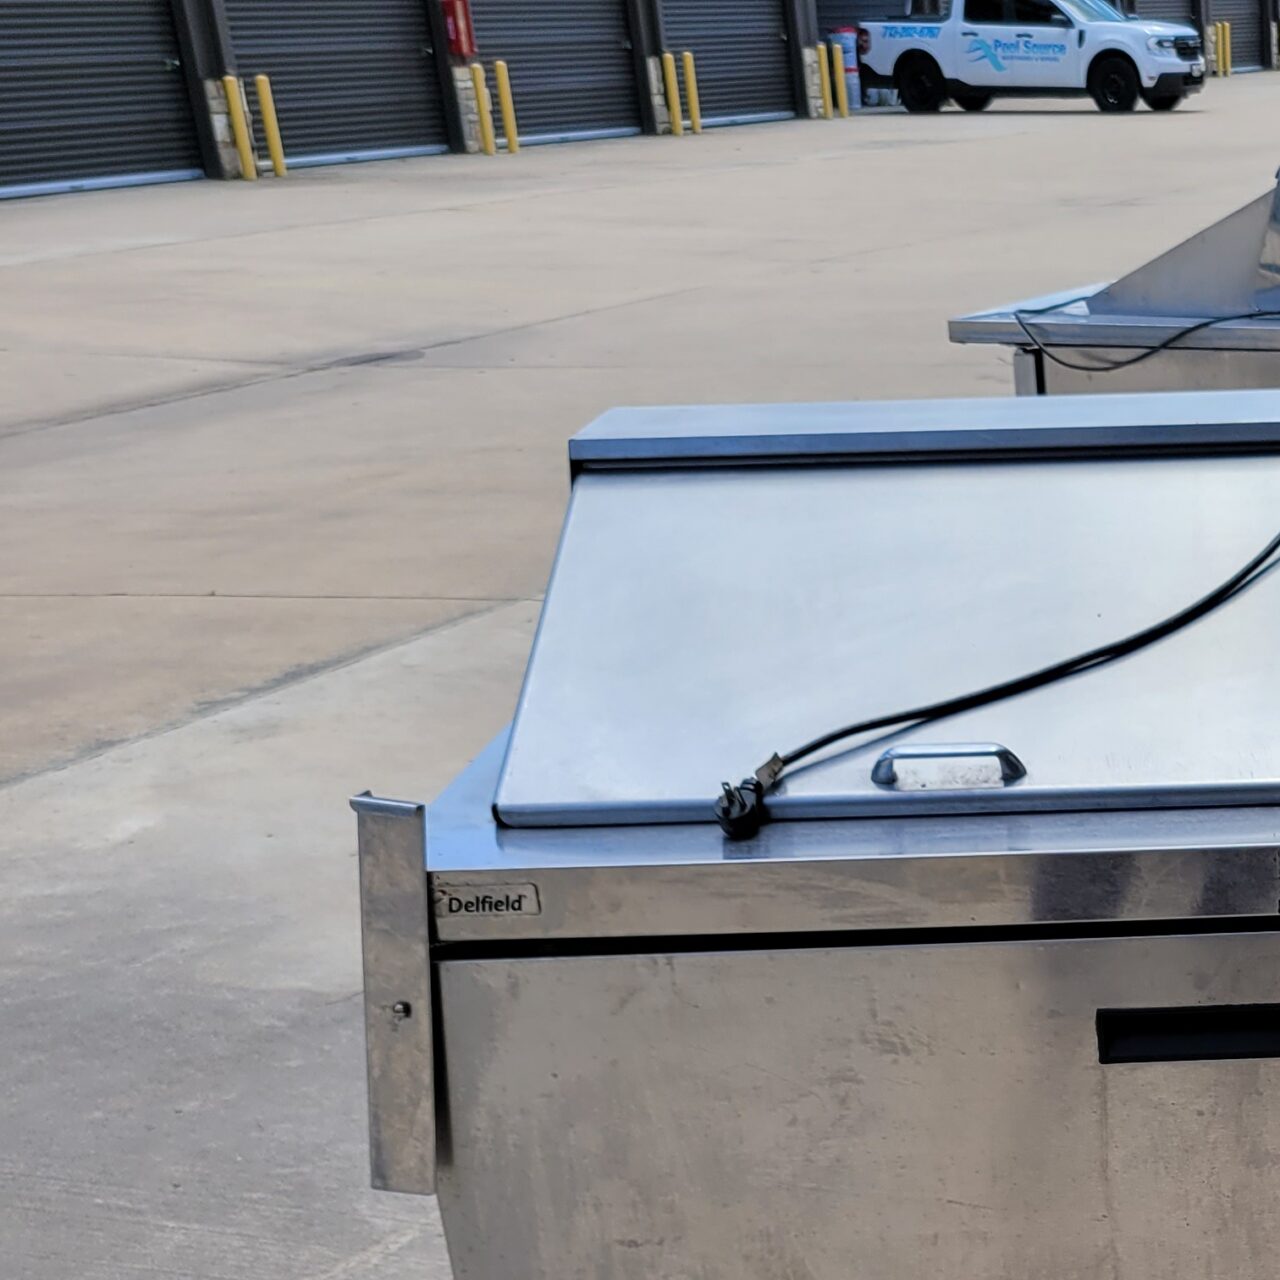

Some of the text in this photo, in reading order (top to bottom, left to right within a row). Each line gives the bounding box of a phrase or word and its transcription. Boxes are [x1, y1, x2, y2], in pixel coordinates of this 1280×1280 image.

[994, 39, 1067, 55] Pool Source
[448, 894, 523, 913] Delfield
